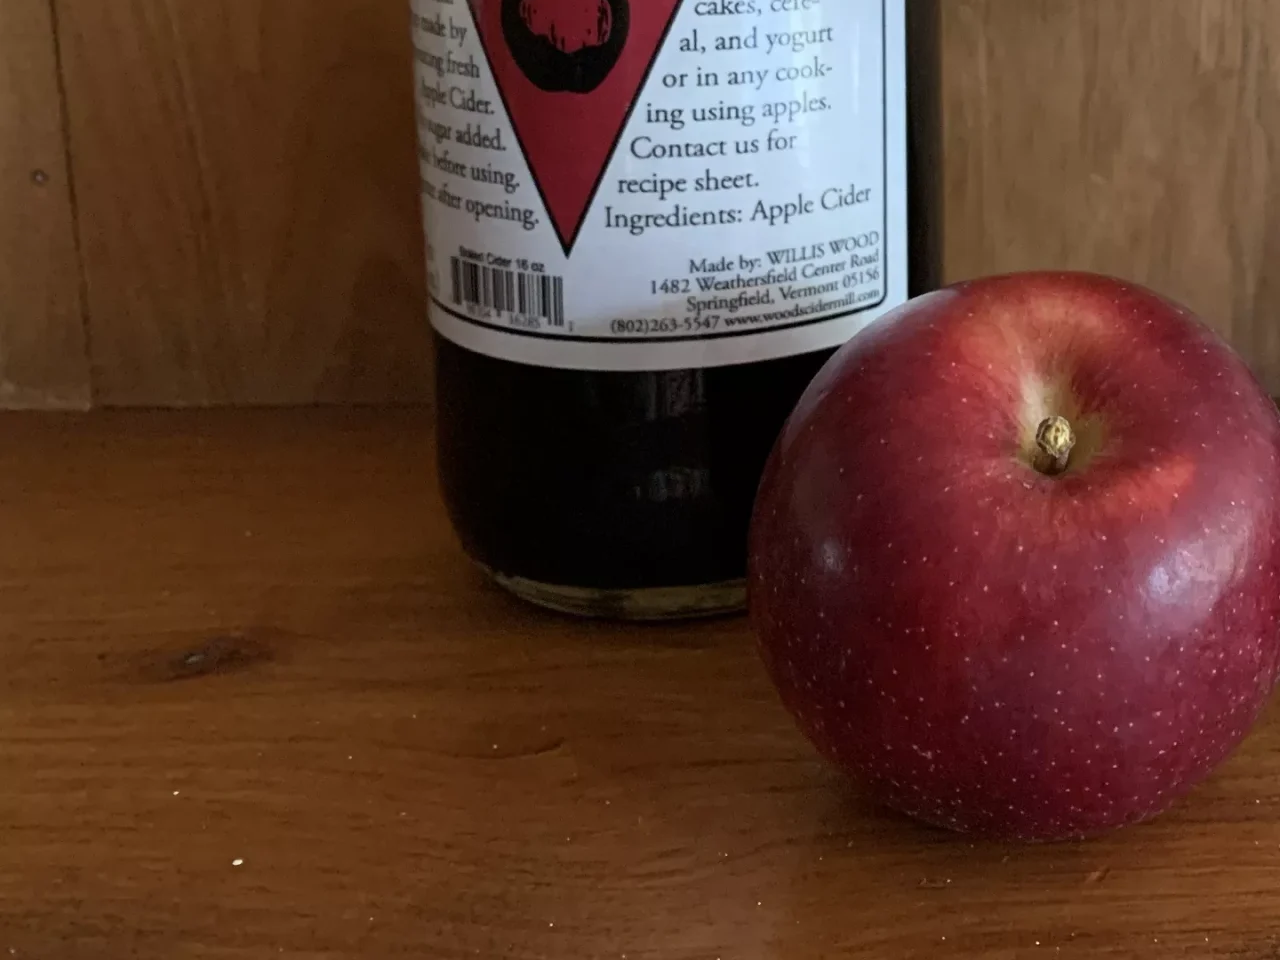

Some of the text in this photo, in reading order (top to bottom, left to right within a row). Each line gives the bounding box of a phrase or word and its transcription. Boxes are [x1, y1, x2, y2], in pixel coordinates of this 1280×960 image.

[449, 17, 467, 48] by
[679, 26, 834, 54] al, and yogurt
[447, 50, 480, 78] fresh
[662, 56, 833, 91] or in any cook-
[450, 86, 495, 115] Cider.
[645, 91, 832, 130] ing using apples.
[455, 123, 507, 151] added.
[630, 129, 798, 160] Contact us for
[470, 163, 520, 194] using.
[618, 169, 759, 201] recipe sheet.
[465, 200, 539, 231] opening.
[604, 184, 872, 236] Ingredients: Apple Cider
[688, 230, 880, 274] Made by: WILLIS WOOD
[650, 248, 880, 295] 1482 Weathersfield Center Road
[780, 280, 839, 301] Vermont
[842, 269, 880, 288] 05156
[610, 289, 880, 334] (802)263-5547 www.woodscidermill.com
